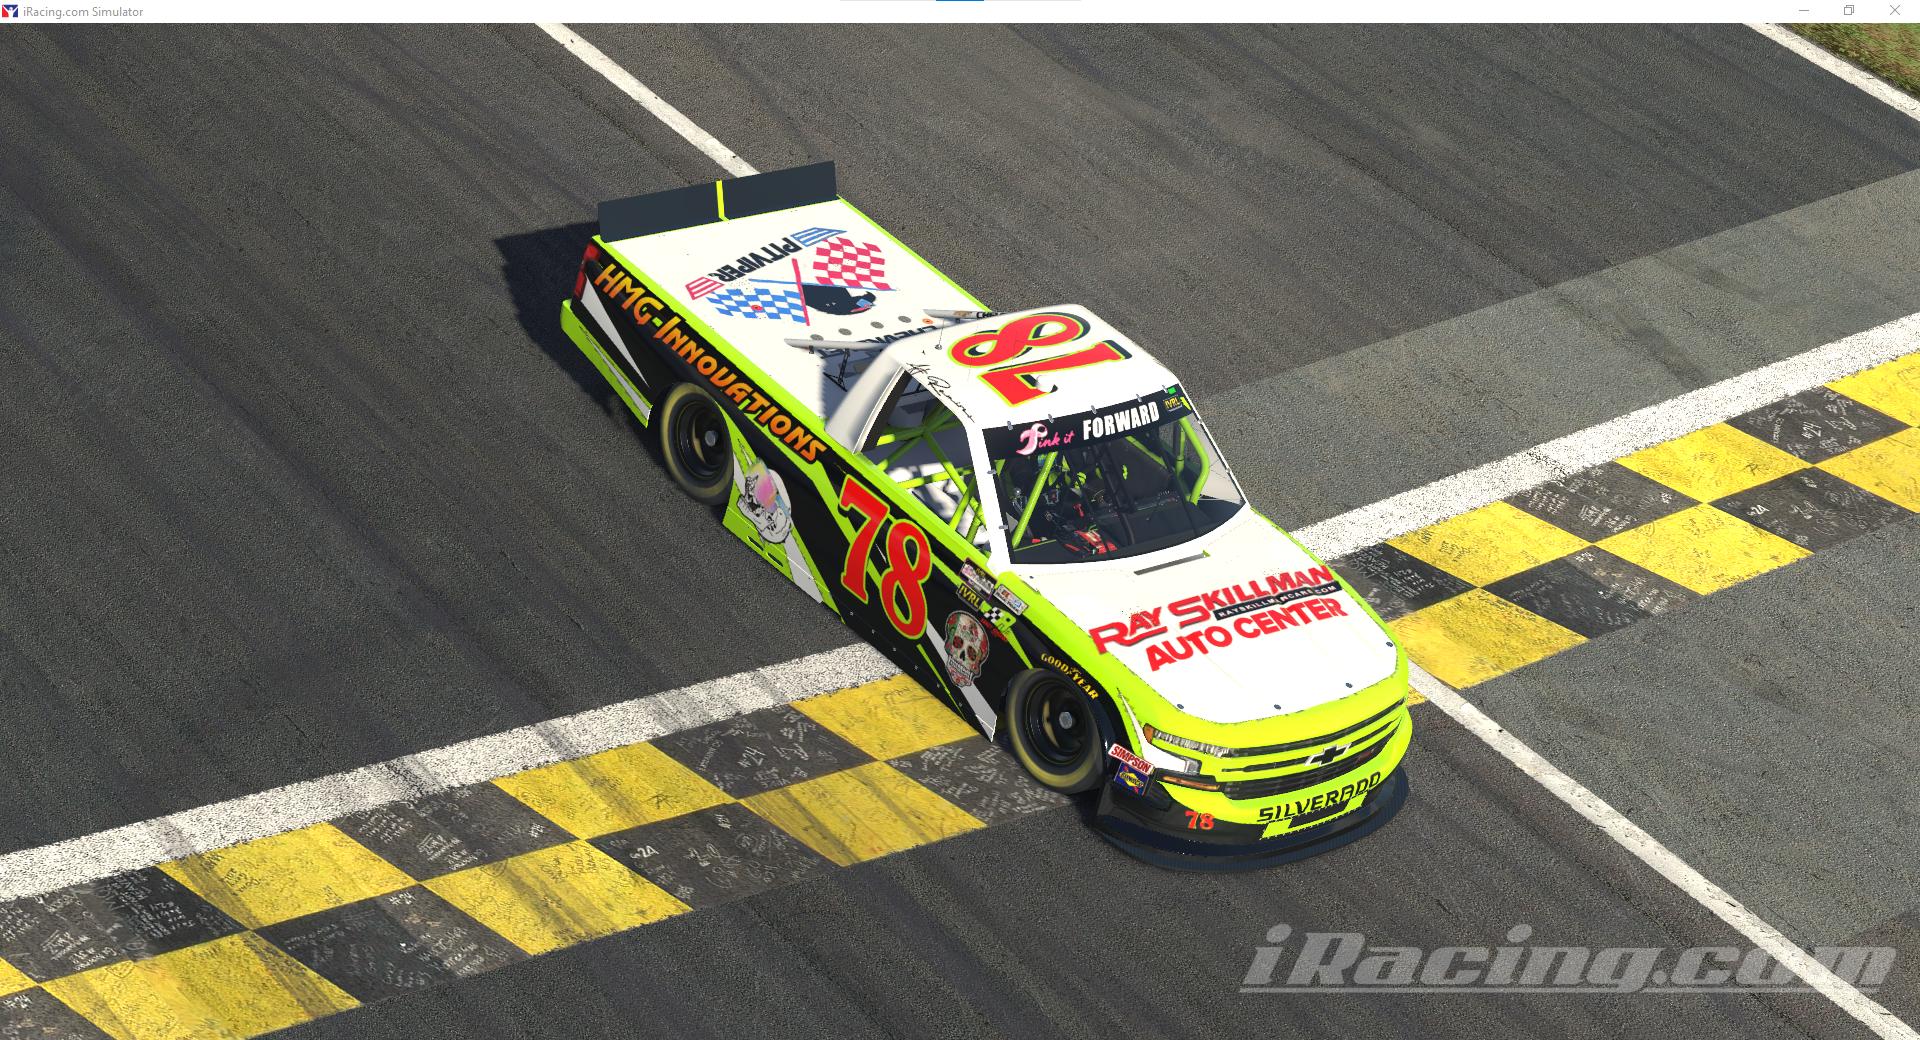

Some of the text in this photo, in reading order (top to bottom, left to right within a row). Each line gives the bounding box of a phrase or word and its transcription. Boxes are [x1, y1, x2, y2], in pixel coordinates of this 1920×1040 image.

[708, 237, 803, 282] PITVIPER
[948, 312, 1132, 407] 78
[1063, 430, 1075, 444] it
[1083, 401, 1160, 440] FORWARD
[840, 474, 931, 640] 78
[1088, 606, 1168, 655] RAY
[1168, 565, 1335, 629] SKILLMAN
[1145, 598, 1348, 672] AUTO CENTER
[1111, 745, 1151, 773] SIMPSON
[1185, 810, 1215, 830] 78
[1257, 771, 1381, 823] SILVERADO
